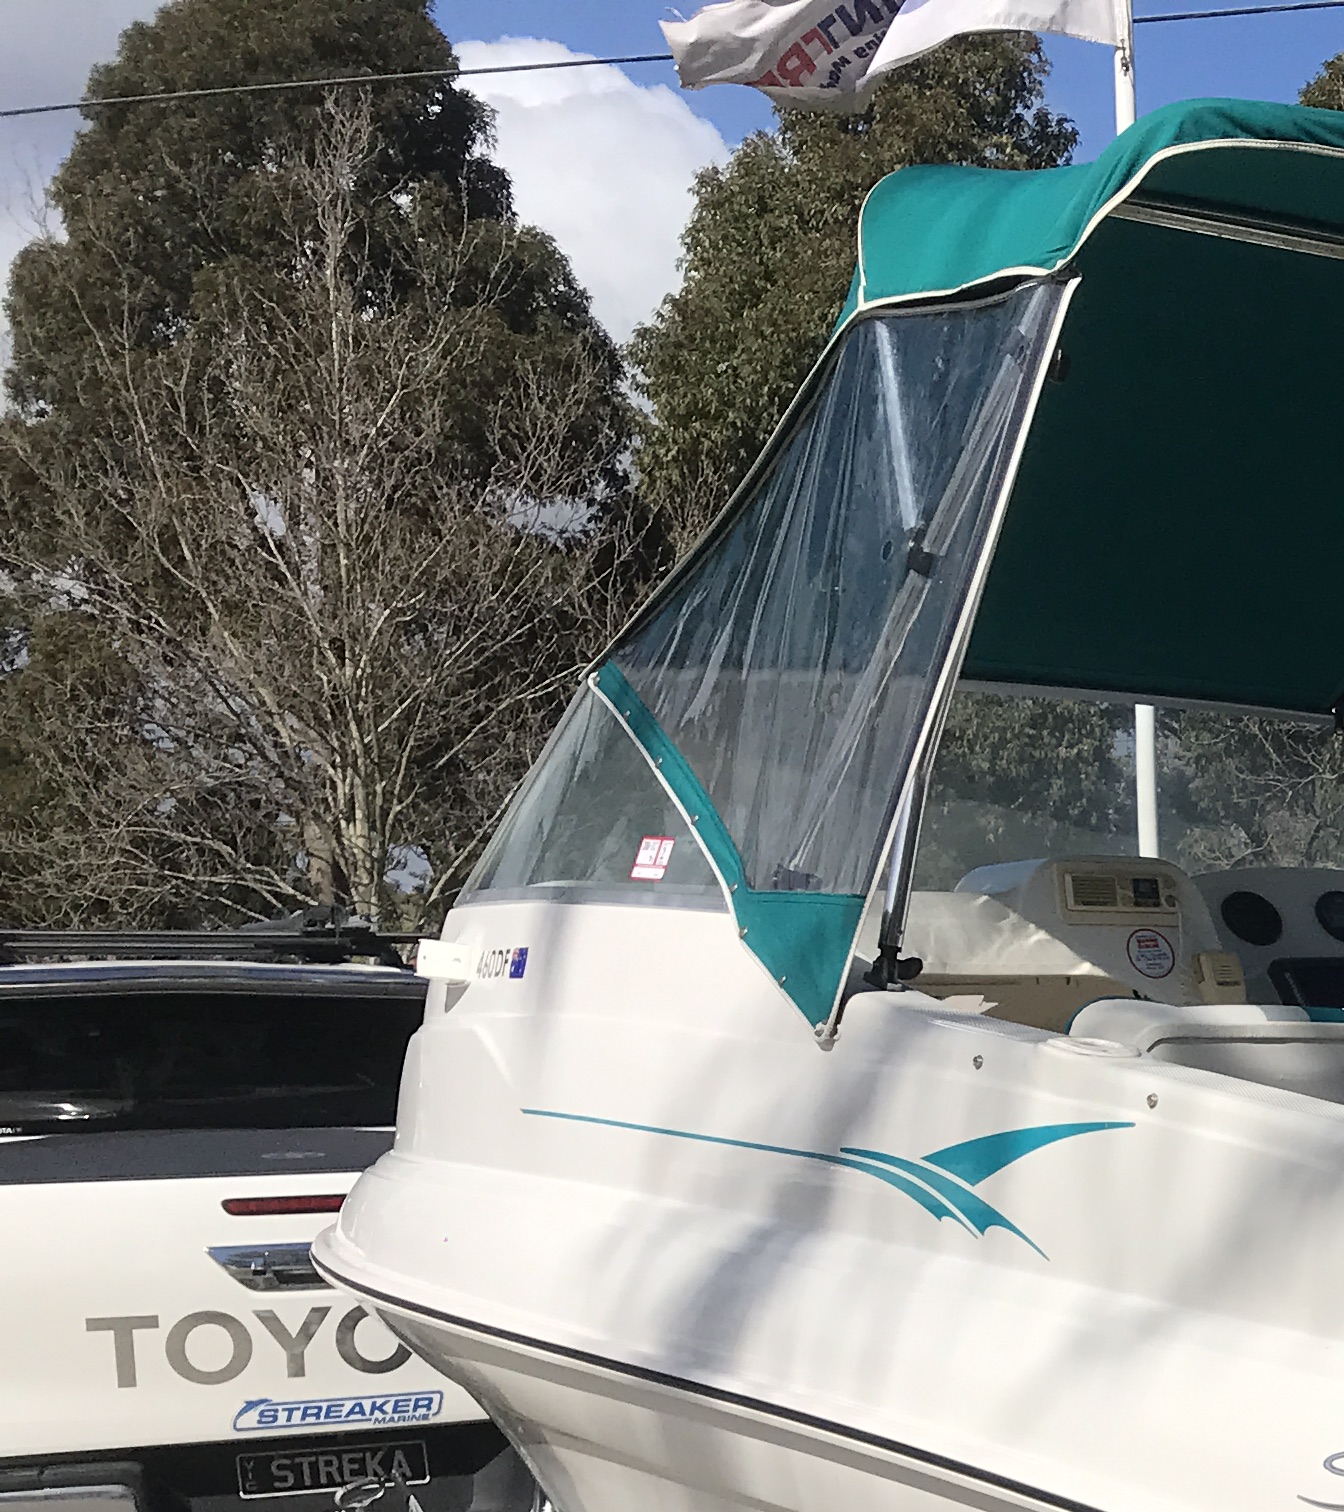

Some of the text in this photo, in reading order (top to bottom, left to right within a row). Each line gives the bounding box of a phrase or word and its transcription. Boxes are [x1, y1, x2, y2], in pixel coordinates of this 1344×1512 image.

[256, 1396, 434, 1425] STREAKER
[373, 1413, 431, 1425] MARINE
[270, 1449, 413, 1489] STREKA
